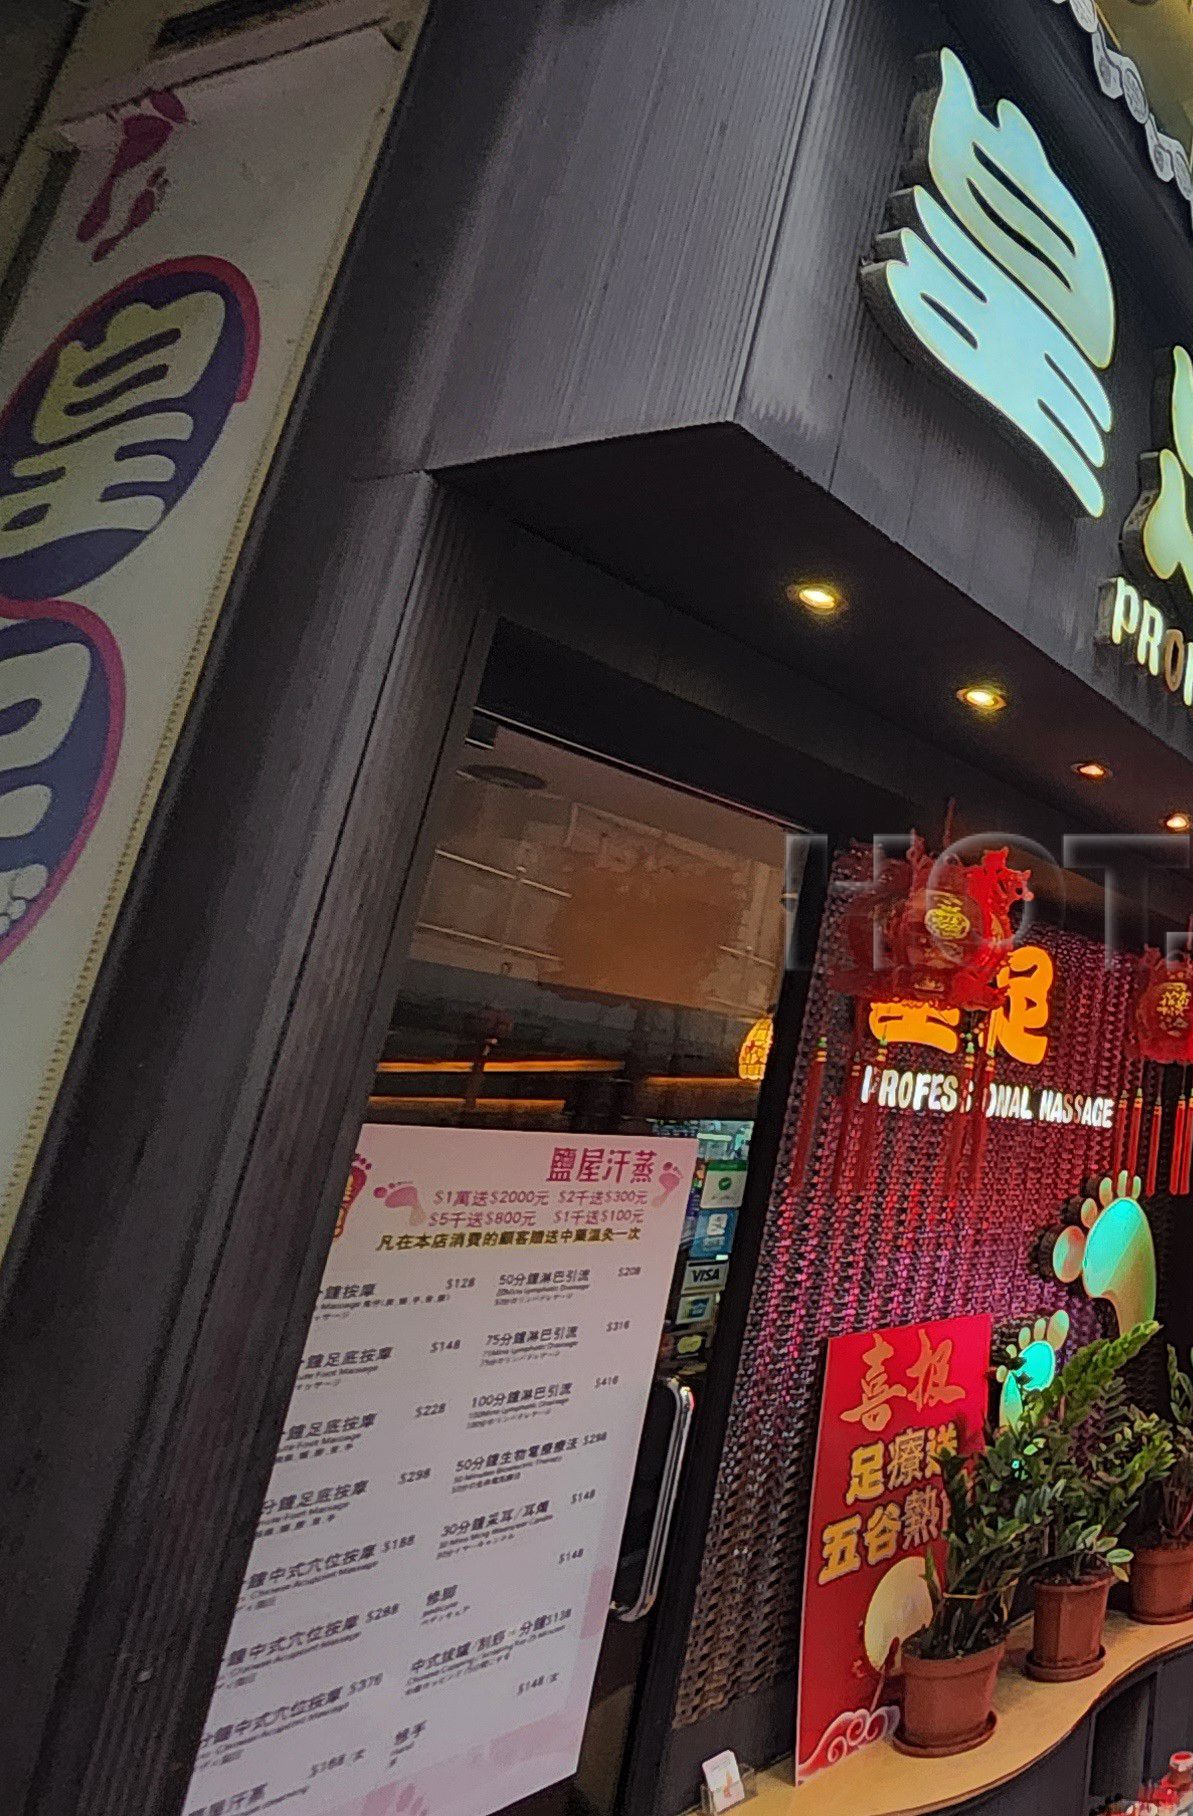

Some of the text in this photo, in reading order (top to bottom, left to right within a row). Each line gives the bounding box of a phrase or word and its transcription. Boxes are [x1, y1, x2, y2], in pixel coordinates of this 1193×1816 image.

[1039, 1088, 1115, 1128] MASSAGE
[546, 1147, 657, 1183] 鹽屋汗蒸
[692, 1266, 720, 1283] VISA
[298, 1346, 394, 1369] 鐘足底按摩
[430, 1339, 461, 1354] $148
[415, 1403, 447, 1418] $228
[281, 1413, 378, 1441] 鐘足底按摩
[818, 1484, 952, 1586] 五谷熱
[242, 1543, 378, 1591] 鐘中式穴位按摩
[220, 1614, 360, 1668] 鐘中式穴位按摩
